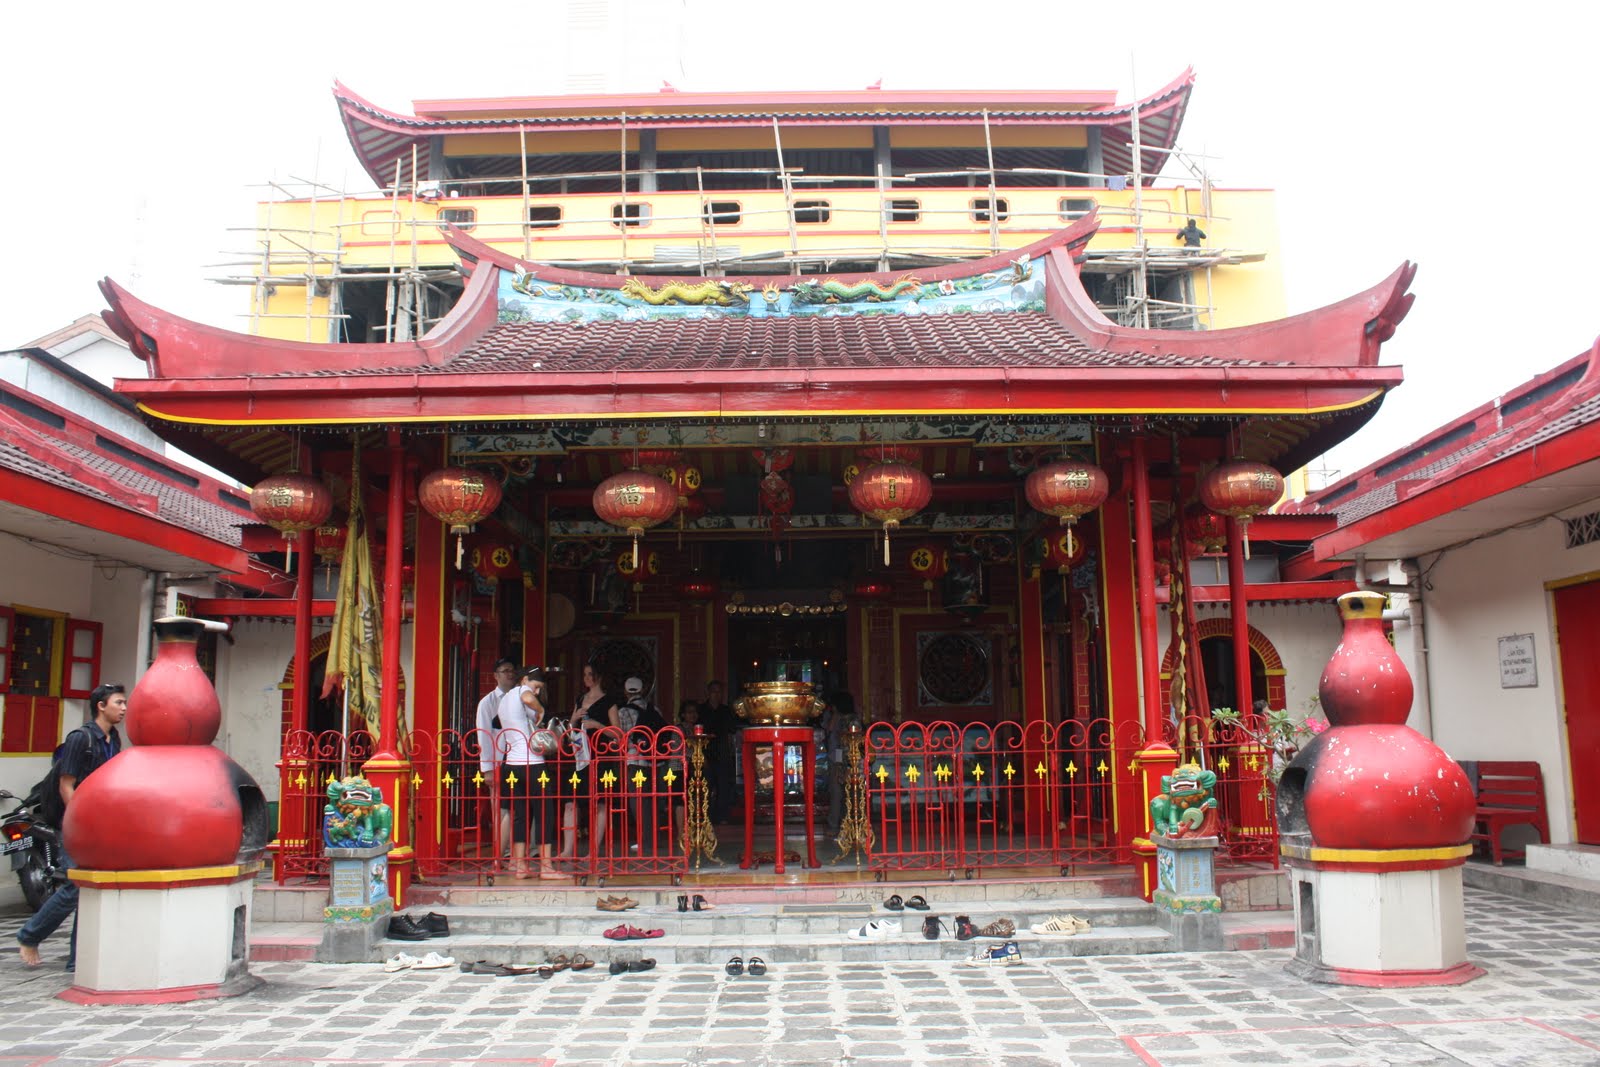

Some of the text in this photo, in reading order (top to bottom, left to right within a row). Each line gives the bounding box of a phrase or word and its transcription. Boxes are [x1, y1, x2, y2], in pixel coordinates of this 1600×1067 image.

[460, 477, 486, 497] 福
[1063, 469, 1091, 490] 福
[1254, 469, 1277, 491] 福
[266, 487, 294, 508] 福
[615, 484, 643, 506] 福
[912, 551, 929, 568] 福
